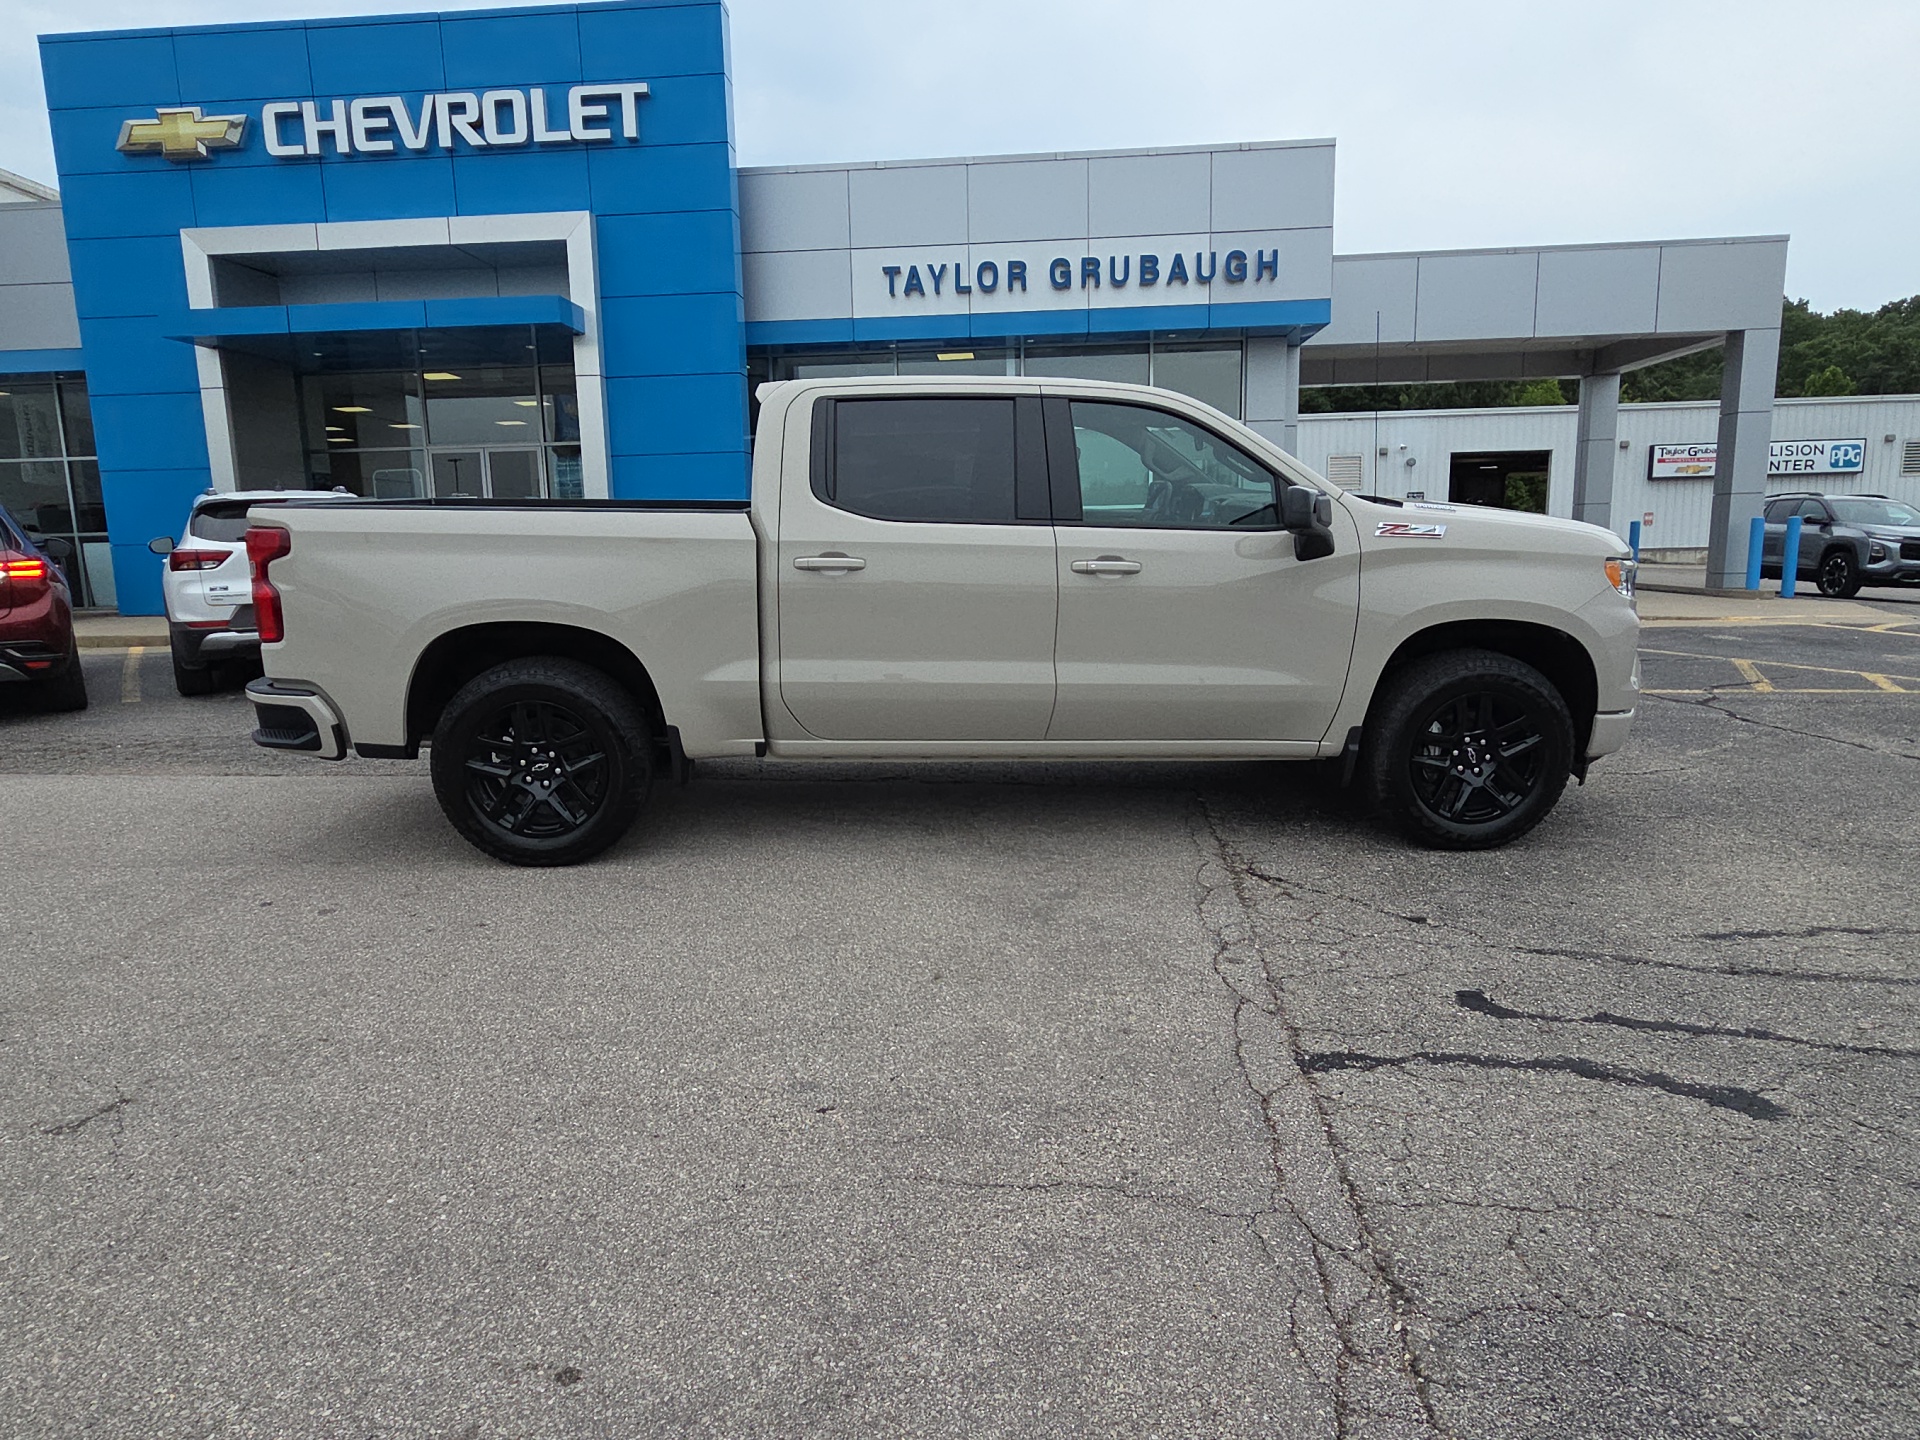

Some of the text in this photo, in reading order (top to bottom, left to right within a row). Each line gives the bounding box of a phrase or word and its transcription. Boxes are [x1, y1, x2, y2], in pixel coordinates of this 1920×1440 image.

[262, 83, 648, 156] CHEVROLET
[882, 248, 1279, 297] TAYLOR GRUBAUGH
[1658, 446, 1717, 457] Taylor Gruba
[1770, 444, 1825, 457] LISION
[1831, 446, 1860, 466] PPG
[1769, 460, 1815, 471] NTER
[1374, 521, 1447, 538] Z71
